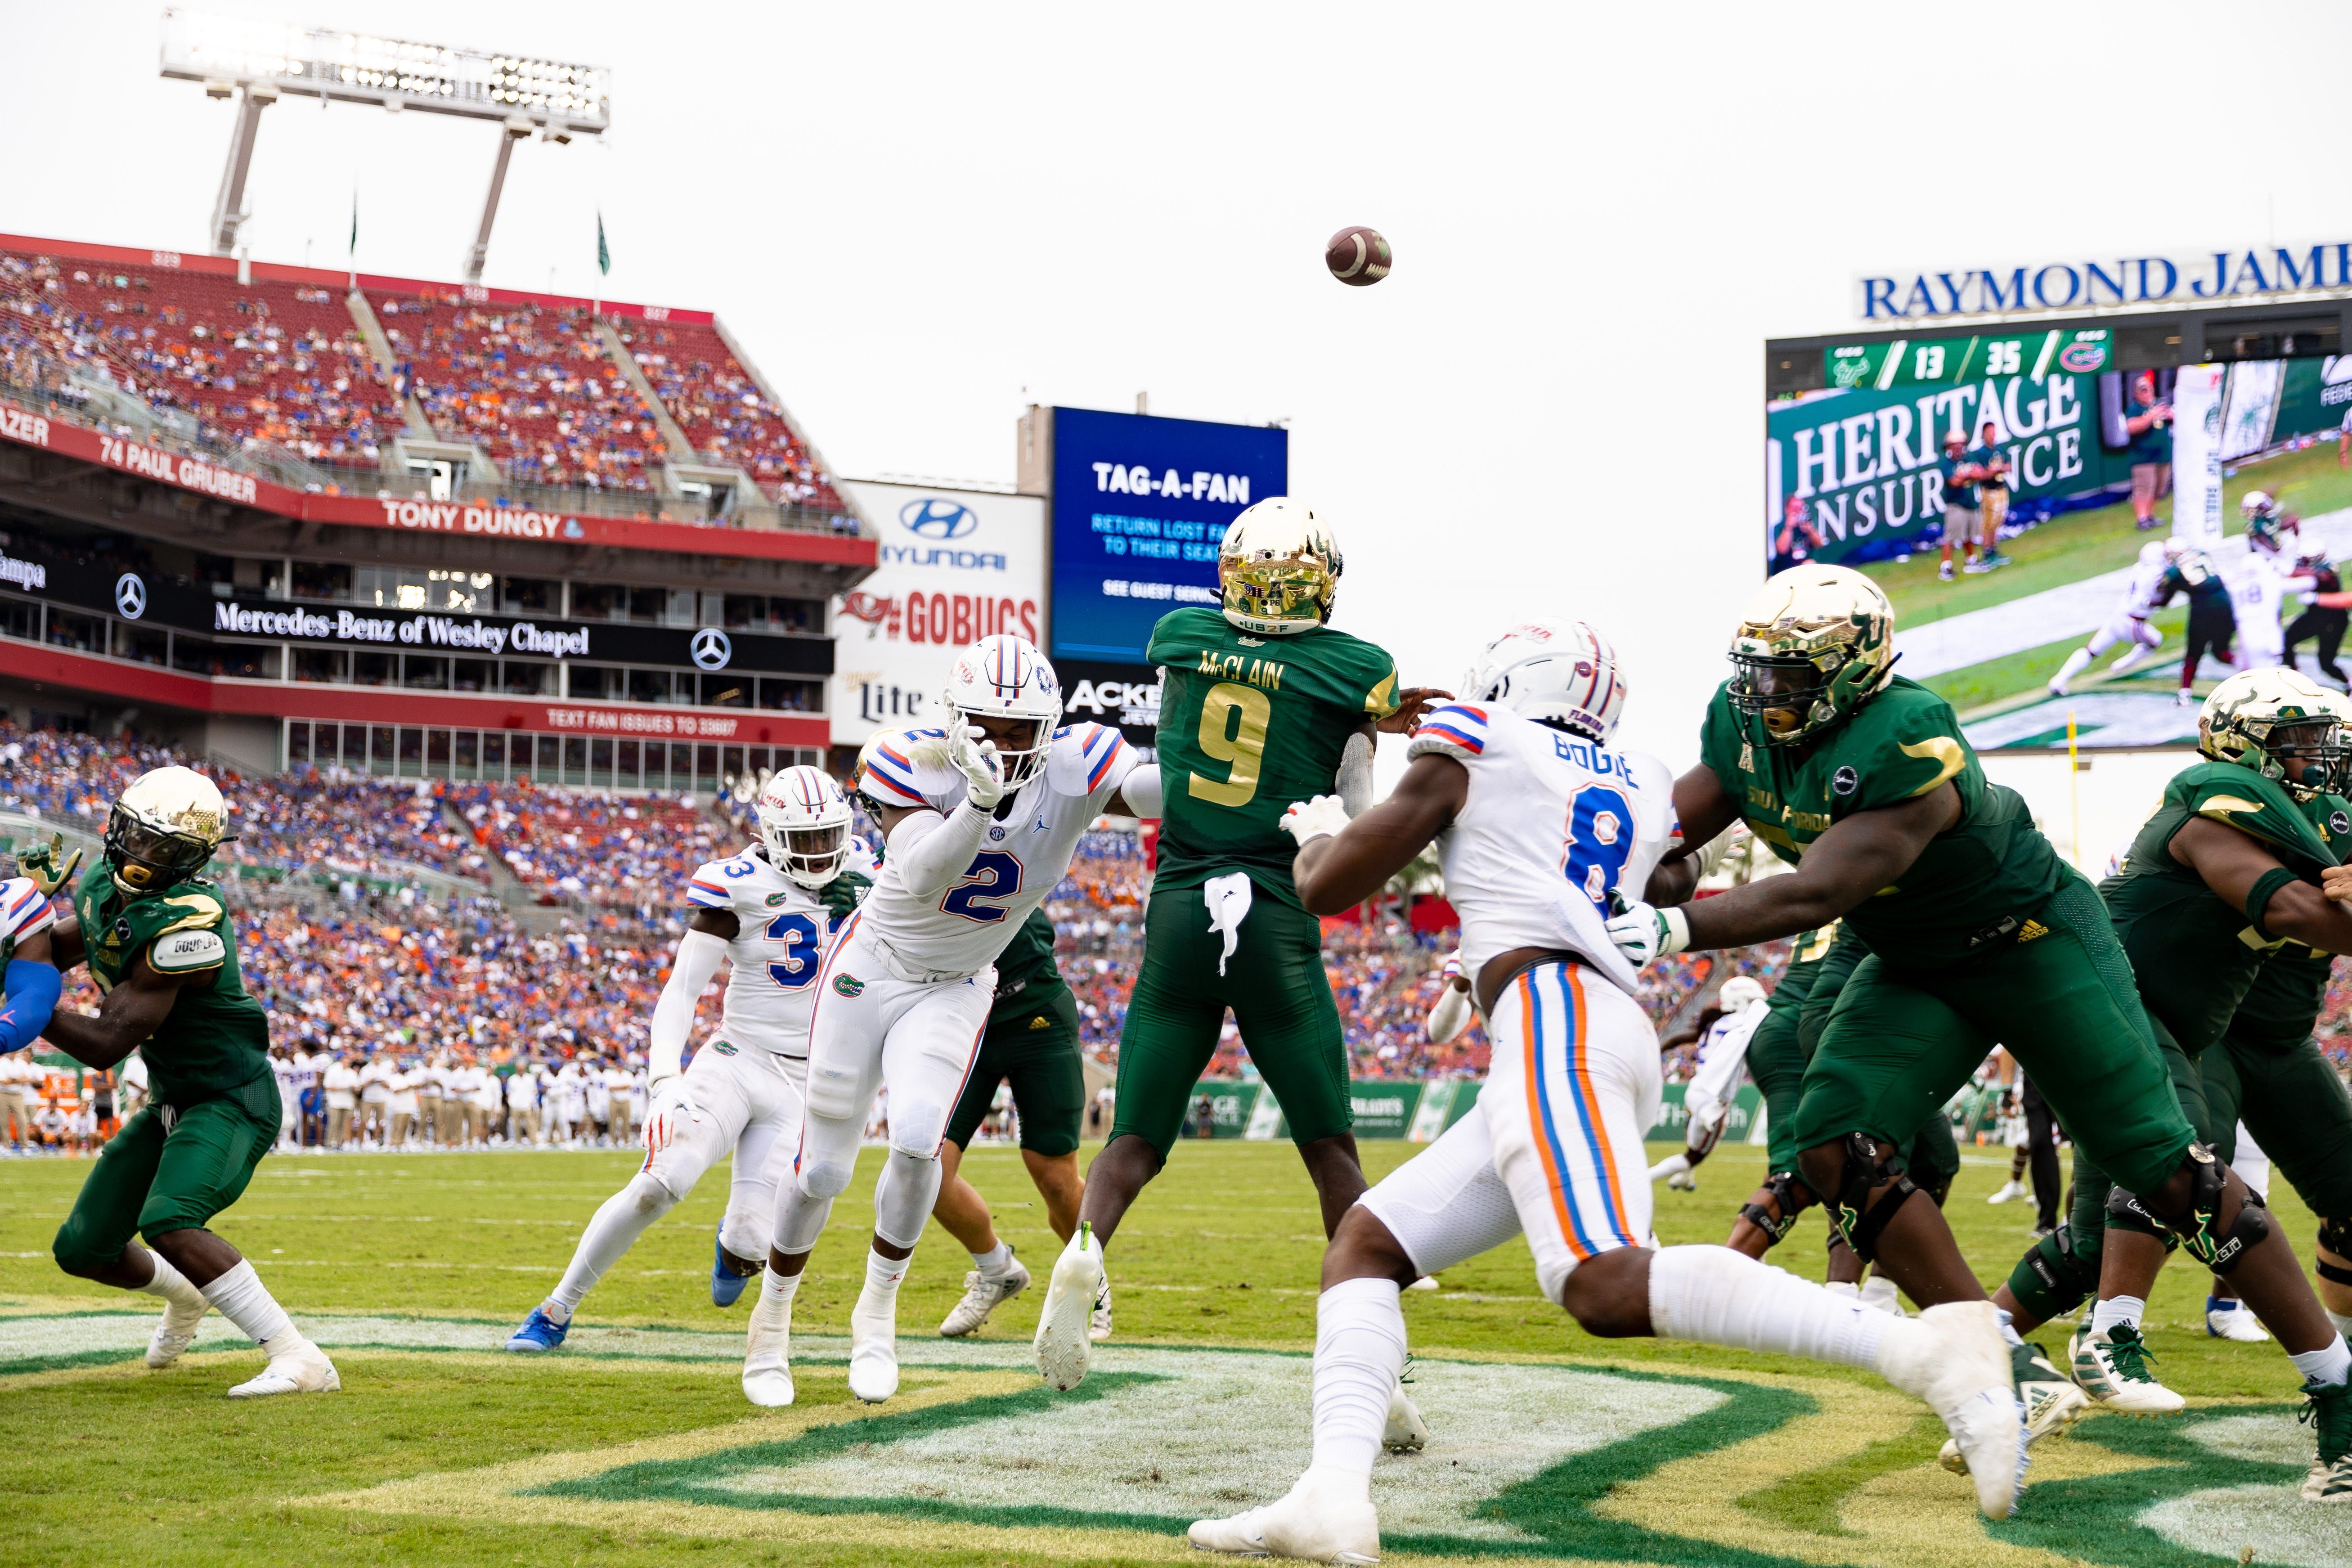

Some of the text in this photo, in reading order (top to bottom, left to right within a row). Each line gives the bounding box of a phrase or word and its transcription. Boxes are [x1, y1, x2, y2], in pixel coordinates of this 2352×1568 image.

[1863, 256, 2177, 320] RAYMOND
[1915, 340, 2022, 380] 13 35
[1793, 373, 2082, 500] HERITAGE
[100, 436, 257, 504] 74 PAUL GRUBER
[1092, 461, 1250, 505] TAG-A-FAN
[1814, 428, 2084, 543] NSURNCE
[383, 501, 561, 539] TONY DUNGY
[1091, 513, 1161, 538] RETURN
[1163, 519, 1206, 541] LOST
[1102, 535, 1127, 555] TO
[1128, 537, 1181, 560] THEIR
[1102, 579, 1130, 598] SEE
[1129, 581, 1174, 600] GUEST
[215, 602, 590, 658] Mercedes-Benz of Wesley Chapel
[546, 708, 587, 728] TEXT
[587, 711, 618, 730] FAN
[619, 713, 674, 733] ISSUES
[675, 715, 698, 734] TO
[861, 681, 922, 723] Lite
[1188, 682, 1271, 808] 9
[991, 827, 1004, 840] SEC
[1560, 782, 1638, 921] 8
[939, 849, 1026, 924] 2
